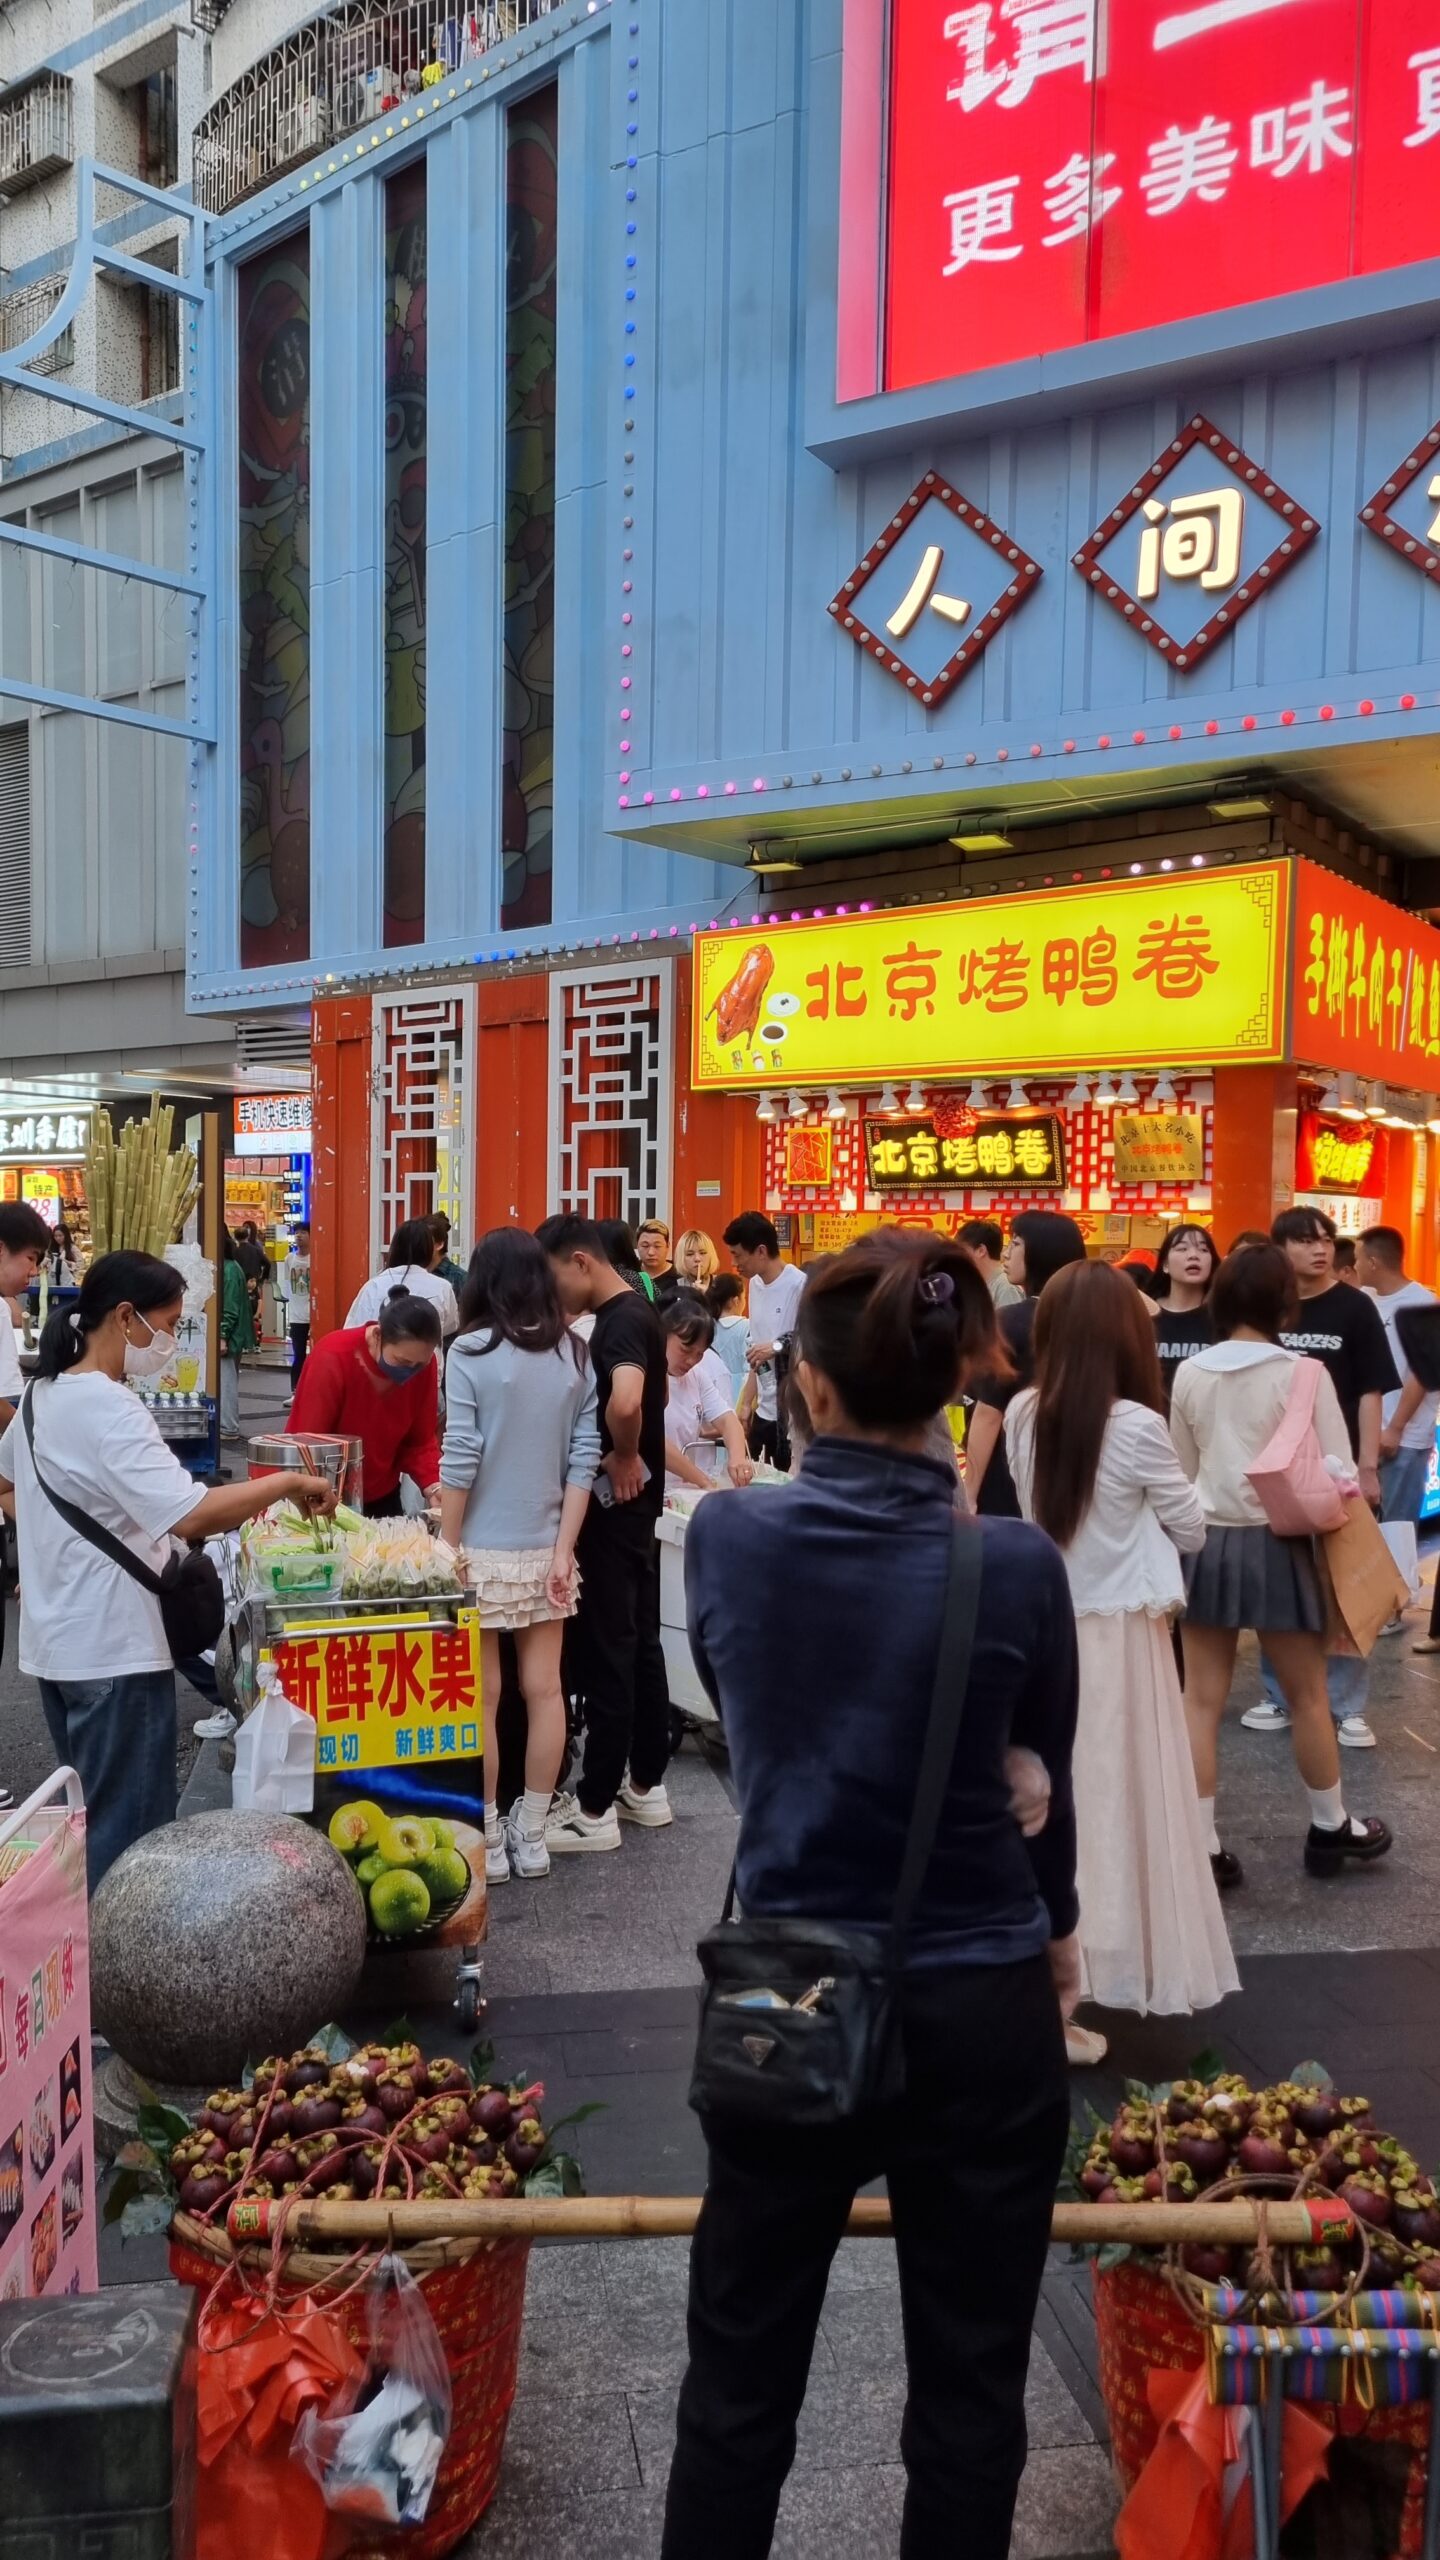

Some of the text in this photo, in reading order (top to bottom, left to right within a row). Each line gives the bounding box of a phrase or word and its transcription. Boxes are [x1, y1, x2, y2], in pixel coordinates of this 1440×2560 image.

[942, 79, 1355, 276] 更多美味
[806, 913, 1220, 1021] 北京烤鸭卷
[872, 1129, 1052, 1176] 北京烤鸭卷
[176, 1318, 198, 1344] 汁
[272, 1629, 476, 1723] 新鲜水果
[319, 1722, 477, 1765] 现切 新鲜爽口
[15, 1932, 74, 2062] 每日现做
